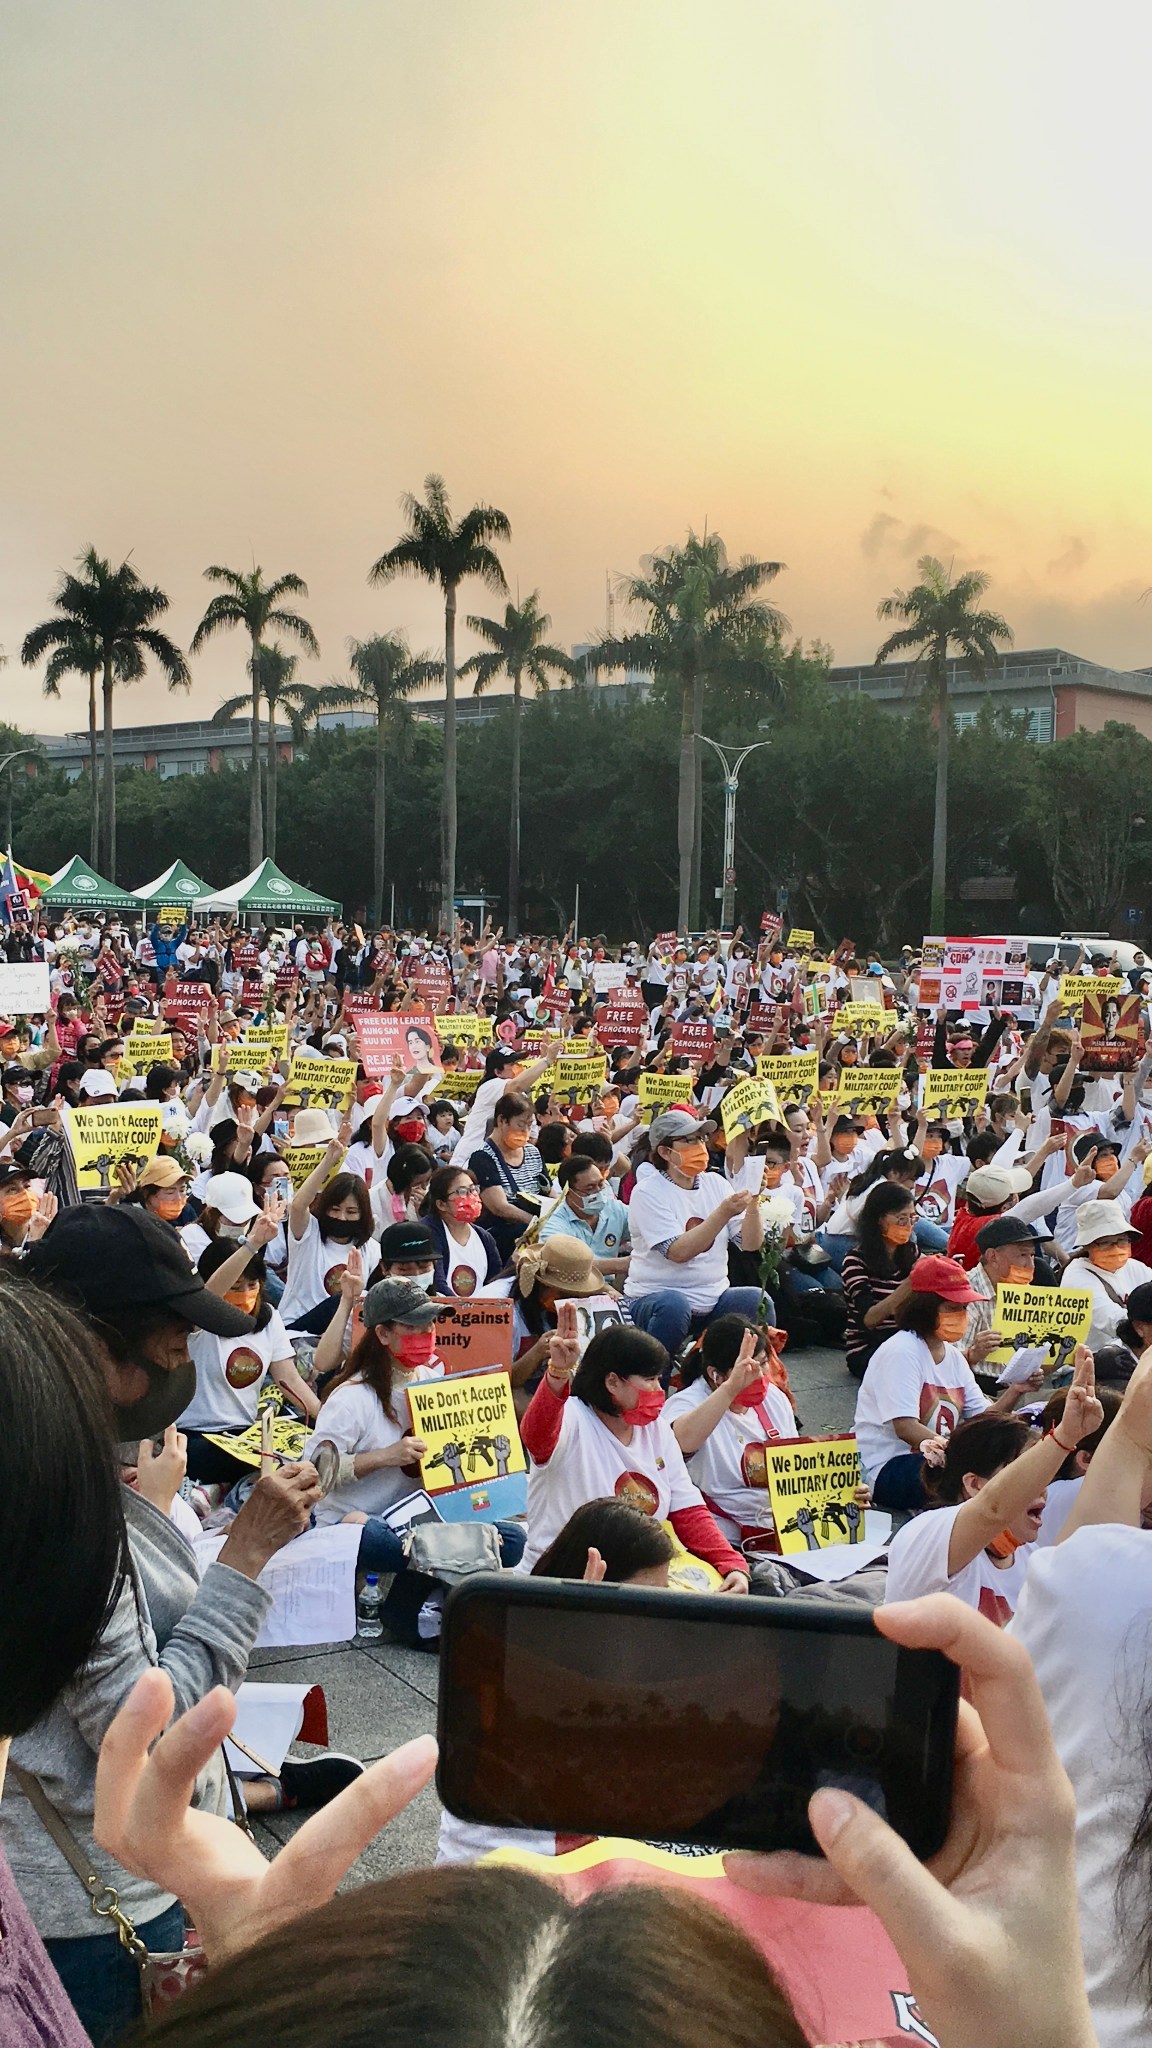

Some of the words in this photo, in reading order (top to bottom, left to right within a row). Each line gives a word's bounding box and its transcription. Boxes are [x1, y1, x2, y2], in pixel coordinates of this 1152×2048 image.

[424, 967, 446, 975] FREE
[176, 984, 204, 994] FREE
[1078, 979, 1096, 987] Don't
[1096, 981, 1120, 989] Accept
[553, 989, 567, 997] FREE
[618, 989, 638, 998] FREE
[168, 999, 210, 1007] DEMOCRACY
[352, 996, 374, 1004] FREE
[358, 1017, 380, 1026] FREE
[607, 1011, 633, 1021] FREE
[682, 1025, 707, 1036] FREE
[674, 1039, 713, 1049] DEMOCRACY
[366, 1054, 405, 1065] REJET
[761, 1060, 775, 1069] We
[776, 1059, 798, 1069] Don't
[799, 1056, 817, 1068] Accept
[294, 1061, 307, 1070] We
[308, 1062, 329, 1071] Don't
[329, 1064, 354, 1075] Accept
[573, 1062, 590, 1071] Don't
[294, 1072, 329, 1082] MILITARY
[330, 1076, 351, 1084] COUP
[560, 1072, 590, 1080] MILITARY
[762, 1070, 798, 1080] MILITARY
[798, 1068, 816, 1078] COUP
[845, 1072, 857, 1081] We
[858, 1072, 878, 1082] Don't
[879, 1072, 900, 1083] Accept
[929, 1073, 941, 1082] We
[943, 1073, 962, 1082] Don't
[964, 1072, 987, 1083] Accept
[646, 1076, 657, 1085] We
[658, 1078, 674, 1087] Don't
[674, 1081, 691, 1091] Accept
[844, 1083, 878, 1091] MILITARY
[879, 1082, 898, 1091] COUP
[930, 1083, 963, 1092] MILITARY
[965, 1082, 983, 1091] COUP
[646, 1086, 674, 1096] MILITARY
[675, 1090, 689, 1098] COUP
[734, 1081, 758, 1100] Don't
[75, 1115, 93, 1128] We
[97, 1115, 126, 1127] Don't
[128, 1116, 158, 1131] Accept
[80, 1132, 130, 1144] MILITARY
[131, 1132, 157, 1144] COUP
[299, 1152, 321, 1160] Don't
[1002, 1290, 1020, 1305] We
[1024, 1292, 1053, 1307] Don't
[1054, 1295, 1089, 1312] Accept
[452, 1310, 510, 1327] against
[1002, 1308, 1055, 1324] MILITARY
[1056, 1311, 1086, 1326] COUP
[435, 1334, 471, 1348] anity
[415, 1394, 434, 1411] We
[438, 1389, 468, 1406] Don't
[470, 1384, 507, 1402] Accept
[421, 1411, 475, 1433] MILITARY
[478, 1404, 507, 1424] COUP
[772, 1456, 791, 1473] We
[794, 1452, 825, 1471] Don't
[828, 1451, 859, 1470] Accep
[776, 1474, 828, 1496] MILITARY
[831, 1470, 861, 1489] COUP
